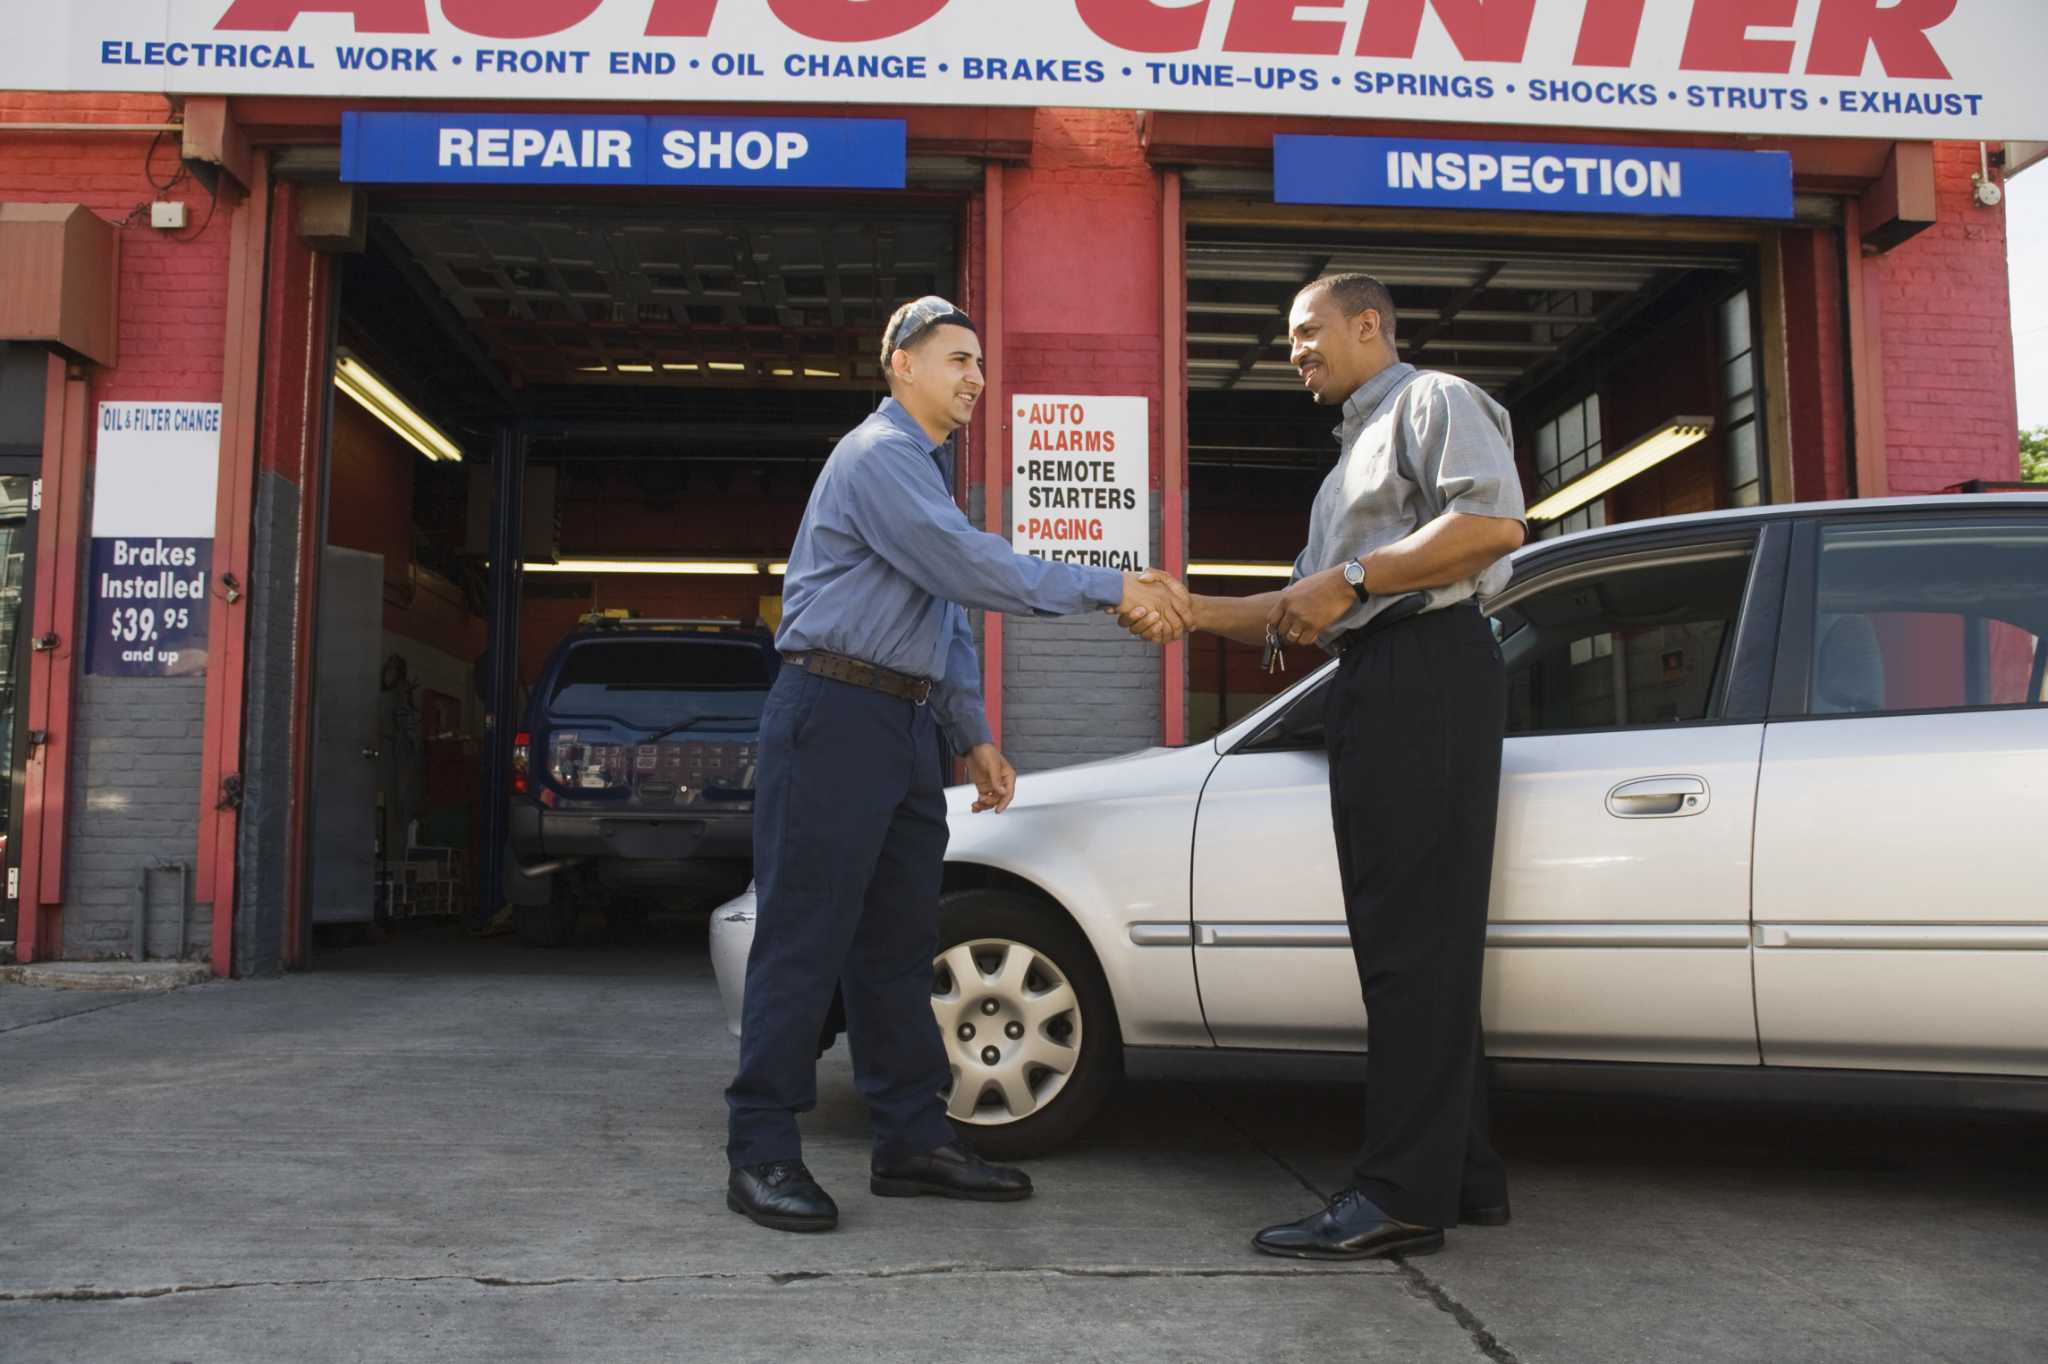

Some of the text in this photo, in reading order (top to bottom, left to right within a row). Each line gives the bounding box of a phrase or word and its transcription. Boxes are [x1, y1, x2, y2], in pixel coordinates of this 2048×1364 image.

[102, 41, 1982, 116] ELECTRICAL WORK FRONT END OIL CHANGE BRAKES TUNE-UPS SPRINGS SHOCKS STRUTS EXHAUST
[438, 128, 808, 171] REPAIR SHOP
[1387, 150, 1681, 199] INSPECTION
[104, 408, 219, 432] OIL & FILTER CHANGE
[1029, 403, 1084, 425] AUTO
[1028, 430, 1115, 452] ALARMS
[1028, 460, 1115, 482] REMOTE
[1028, 486, 1136, 510] STARTERS
[1028, 518, 1103, 541] PAGING
[113, 539, 196, 567] Brakes
[1028, 549, 1143, 572] ECTRICAL
[101, 572, 205, 600] Installed
[121, 646, 180, 668] and up
